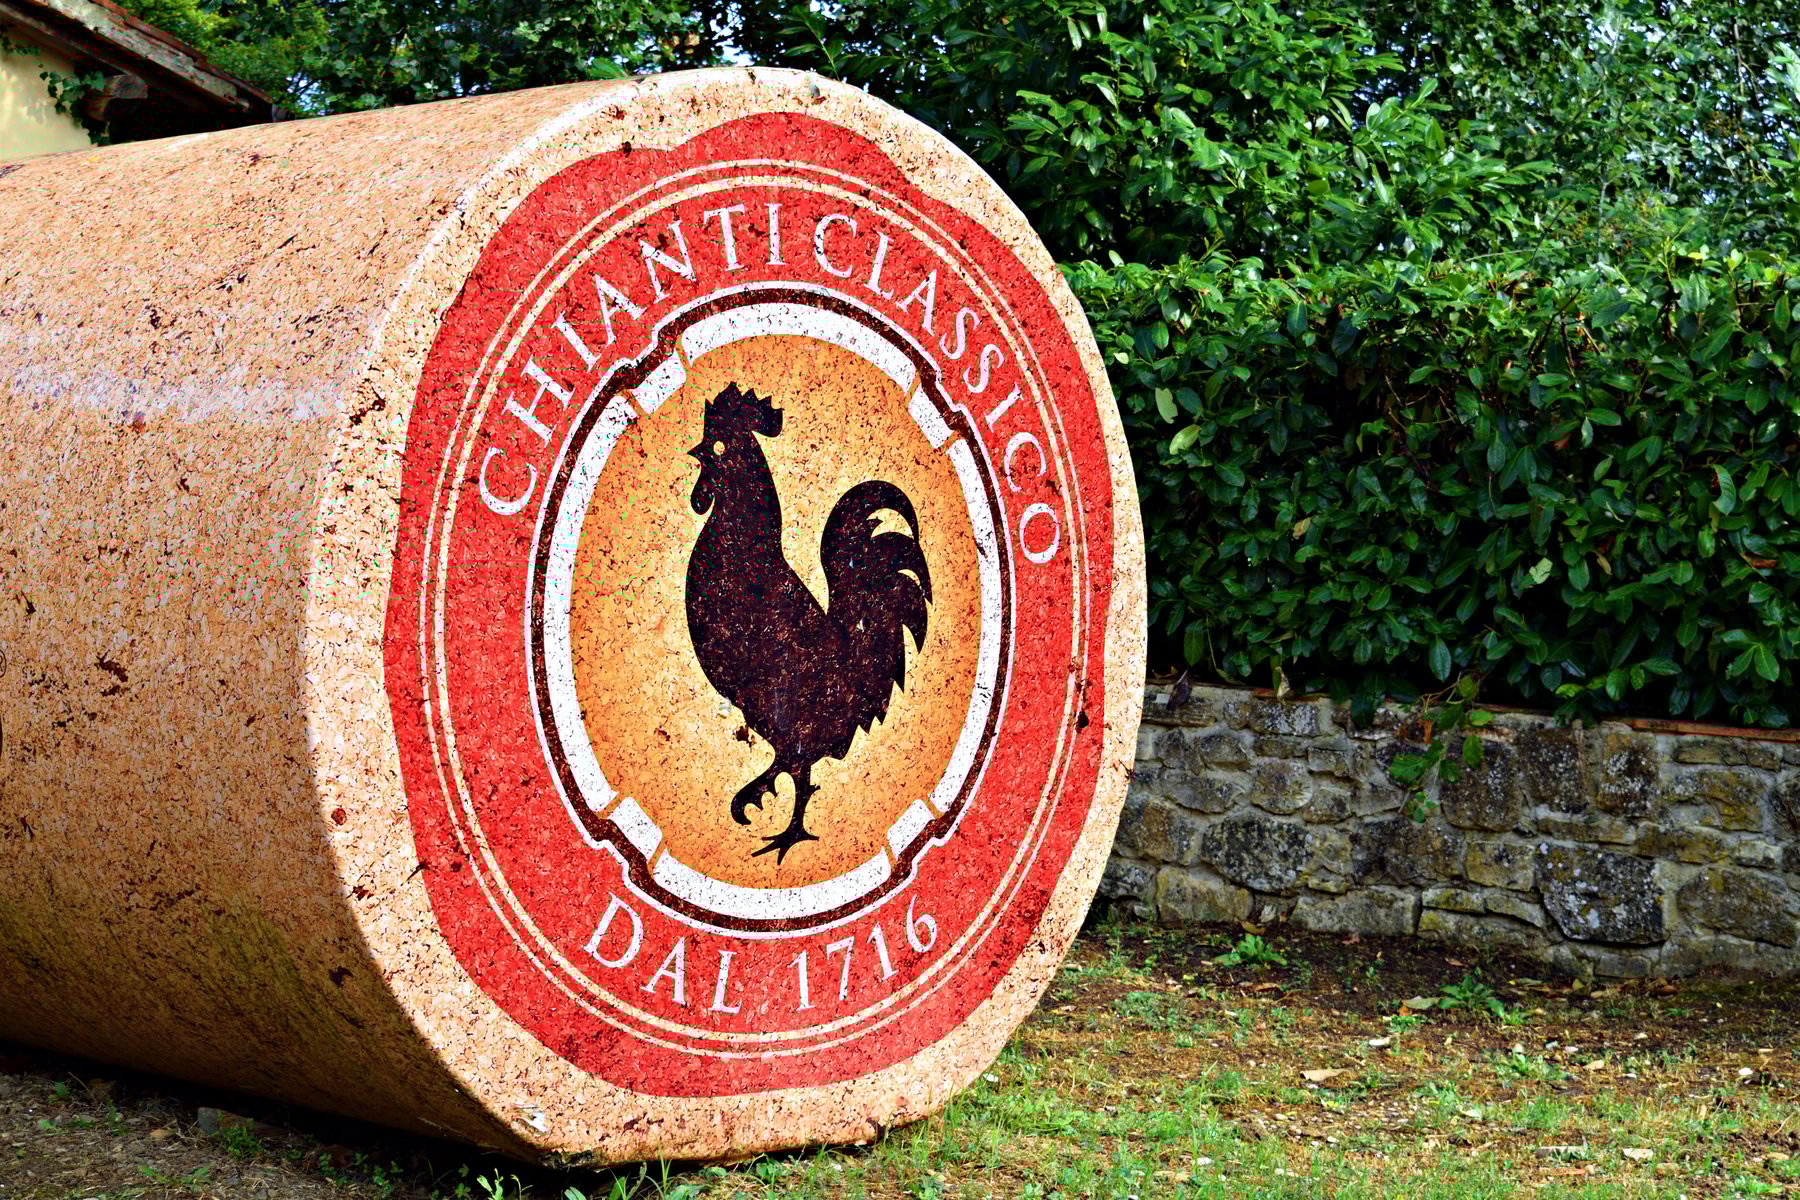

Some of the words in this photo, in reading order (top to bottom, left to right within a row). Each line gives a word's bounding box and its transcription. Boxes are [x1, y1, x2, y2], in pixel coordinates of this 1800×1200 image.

[479, 203, 783, 516] CHIANTI
[813, 213, 1060, 564] CLASSICO
[582, 892, 742, 1014] DAL
[787, 894, 937, 1011] 1716
